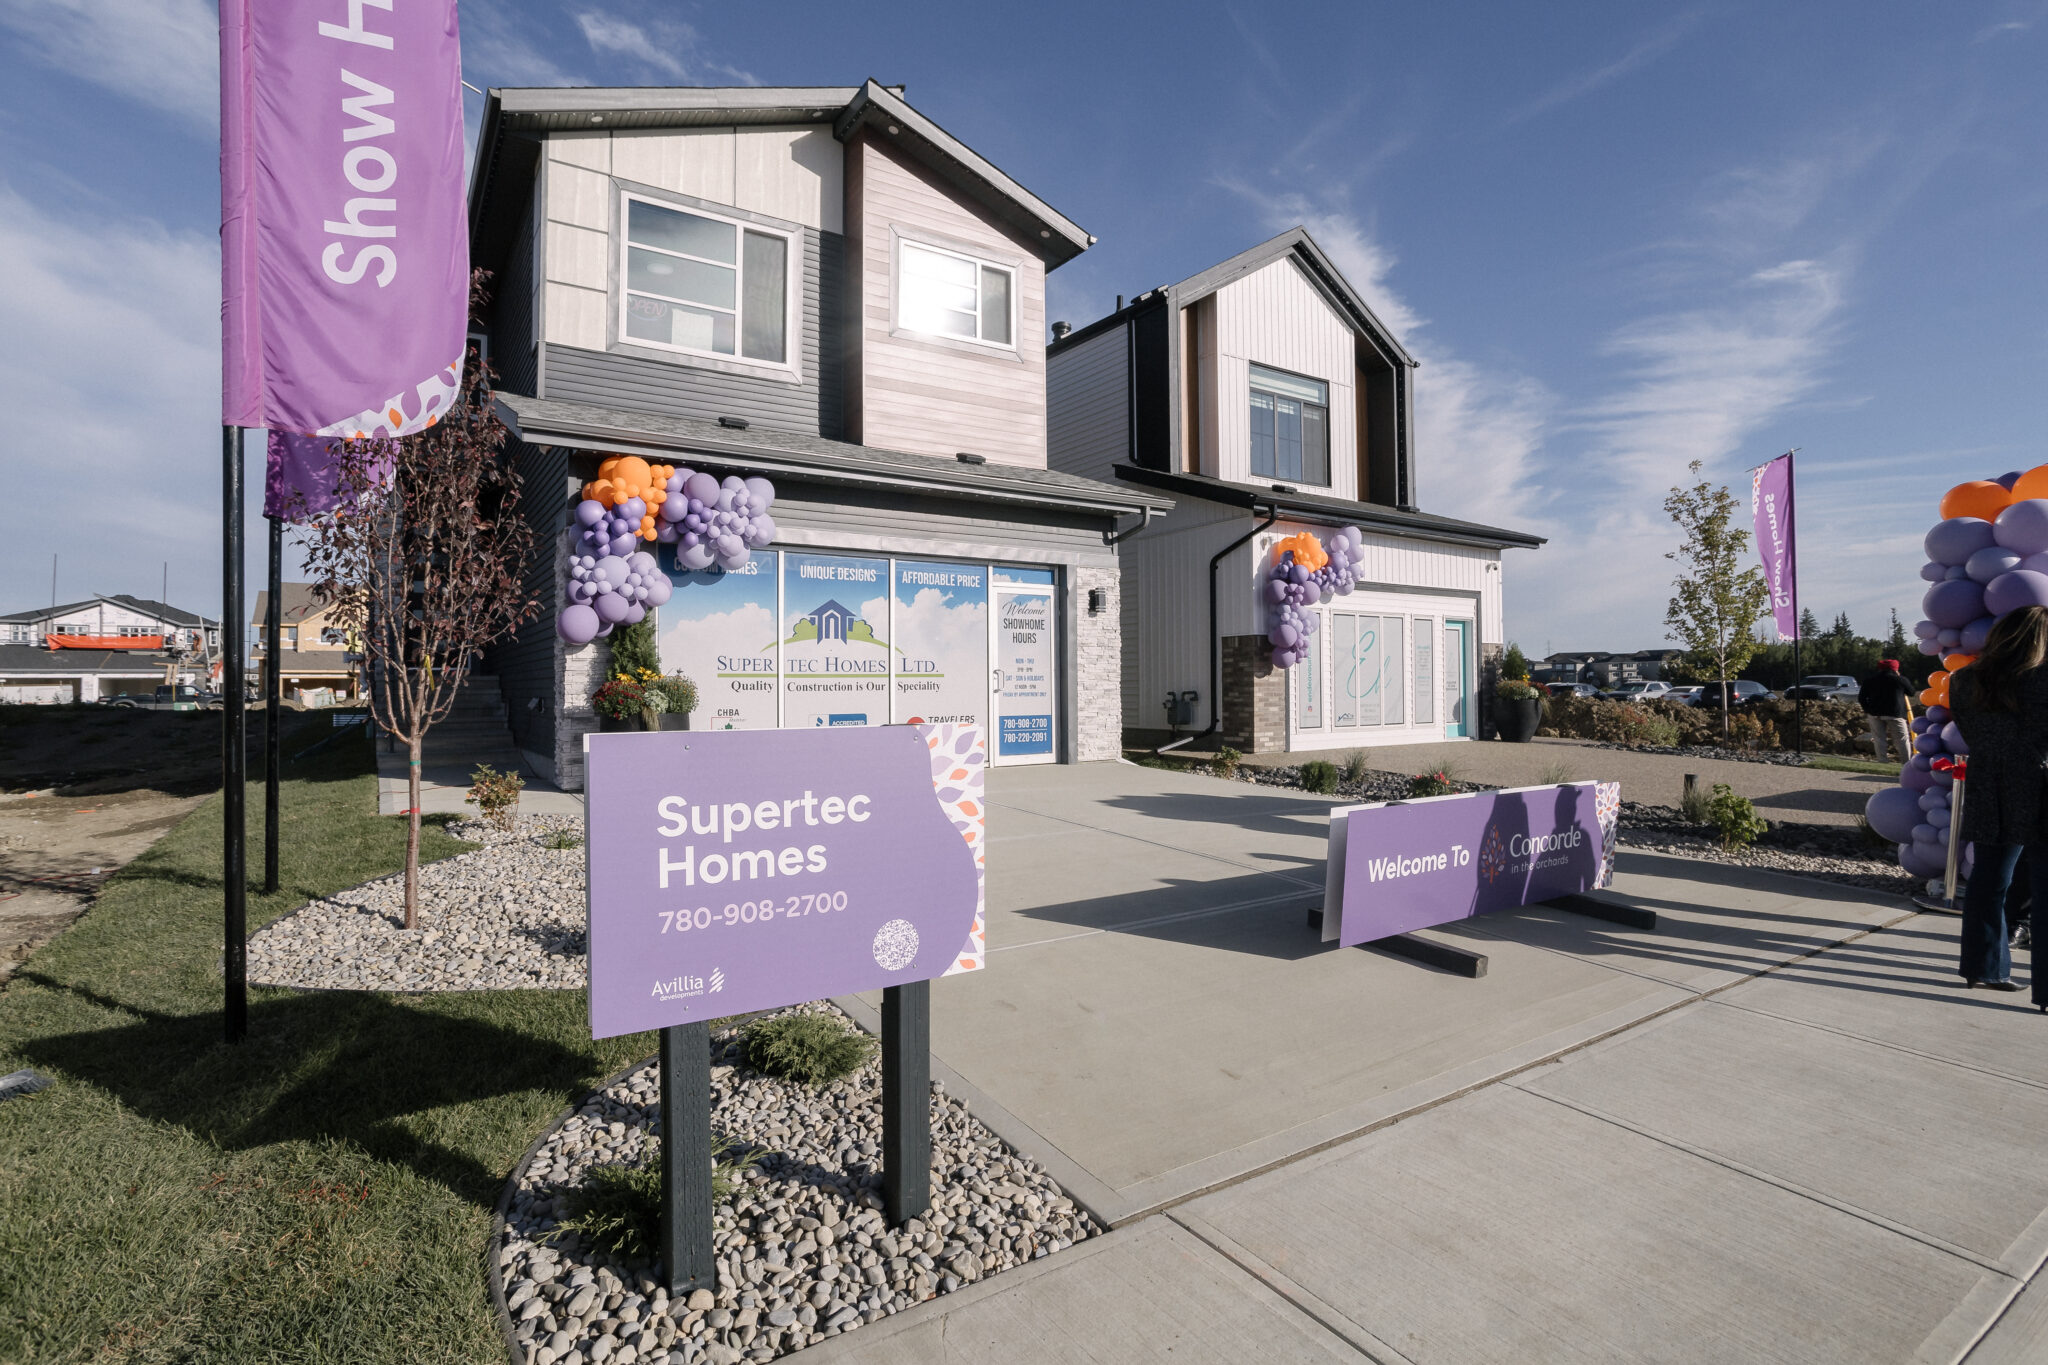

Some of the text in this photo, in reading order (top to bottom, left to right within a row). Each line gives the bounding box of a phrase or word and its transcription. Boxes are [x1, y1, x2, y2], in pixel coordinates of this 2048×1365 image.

[322, 68, 397, 288] Show
[800, 565, 877, 582] UNIQUE DESIGNS
[902, 571, 981, 588] AFFORDABLE PRICE
[1002, 601, 1045, 616] Welcome
[1003, 618, 1045, 630] SHOWHOME
[1012, 632, 1037, 644] HOURS
[717, 655, 939, 673] SUPER TEC HOMES LTD.
[731, 680, 941, 693] Quality Construction is Our Speciality
[717, 708, 740, 716] CHBA
[1003, 718, 1048, 729] 780-908-2700
[1003, 732, 1047, 743] 780-220-2091
[657, 790, 871, 843] Supertec
[1510, 825, 1582, 858] Concorde
[659, 844, 828, 889] Homes
[1368, 844, 1470, 883] Welcome To
[1511, 855, 1569, 874] in the orchards
[658, 891, 848, 934] 780-908-2700
[651, 975, 704, 997] Avillia
[660, 989, 704, 1001] developments
